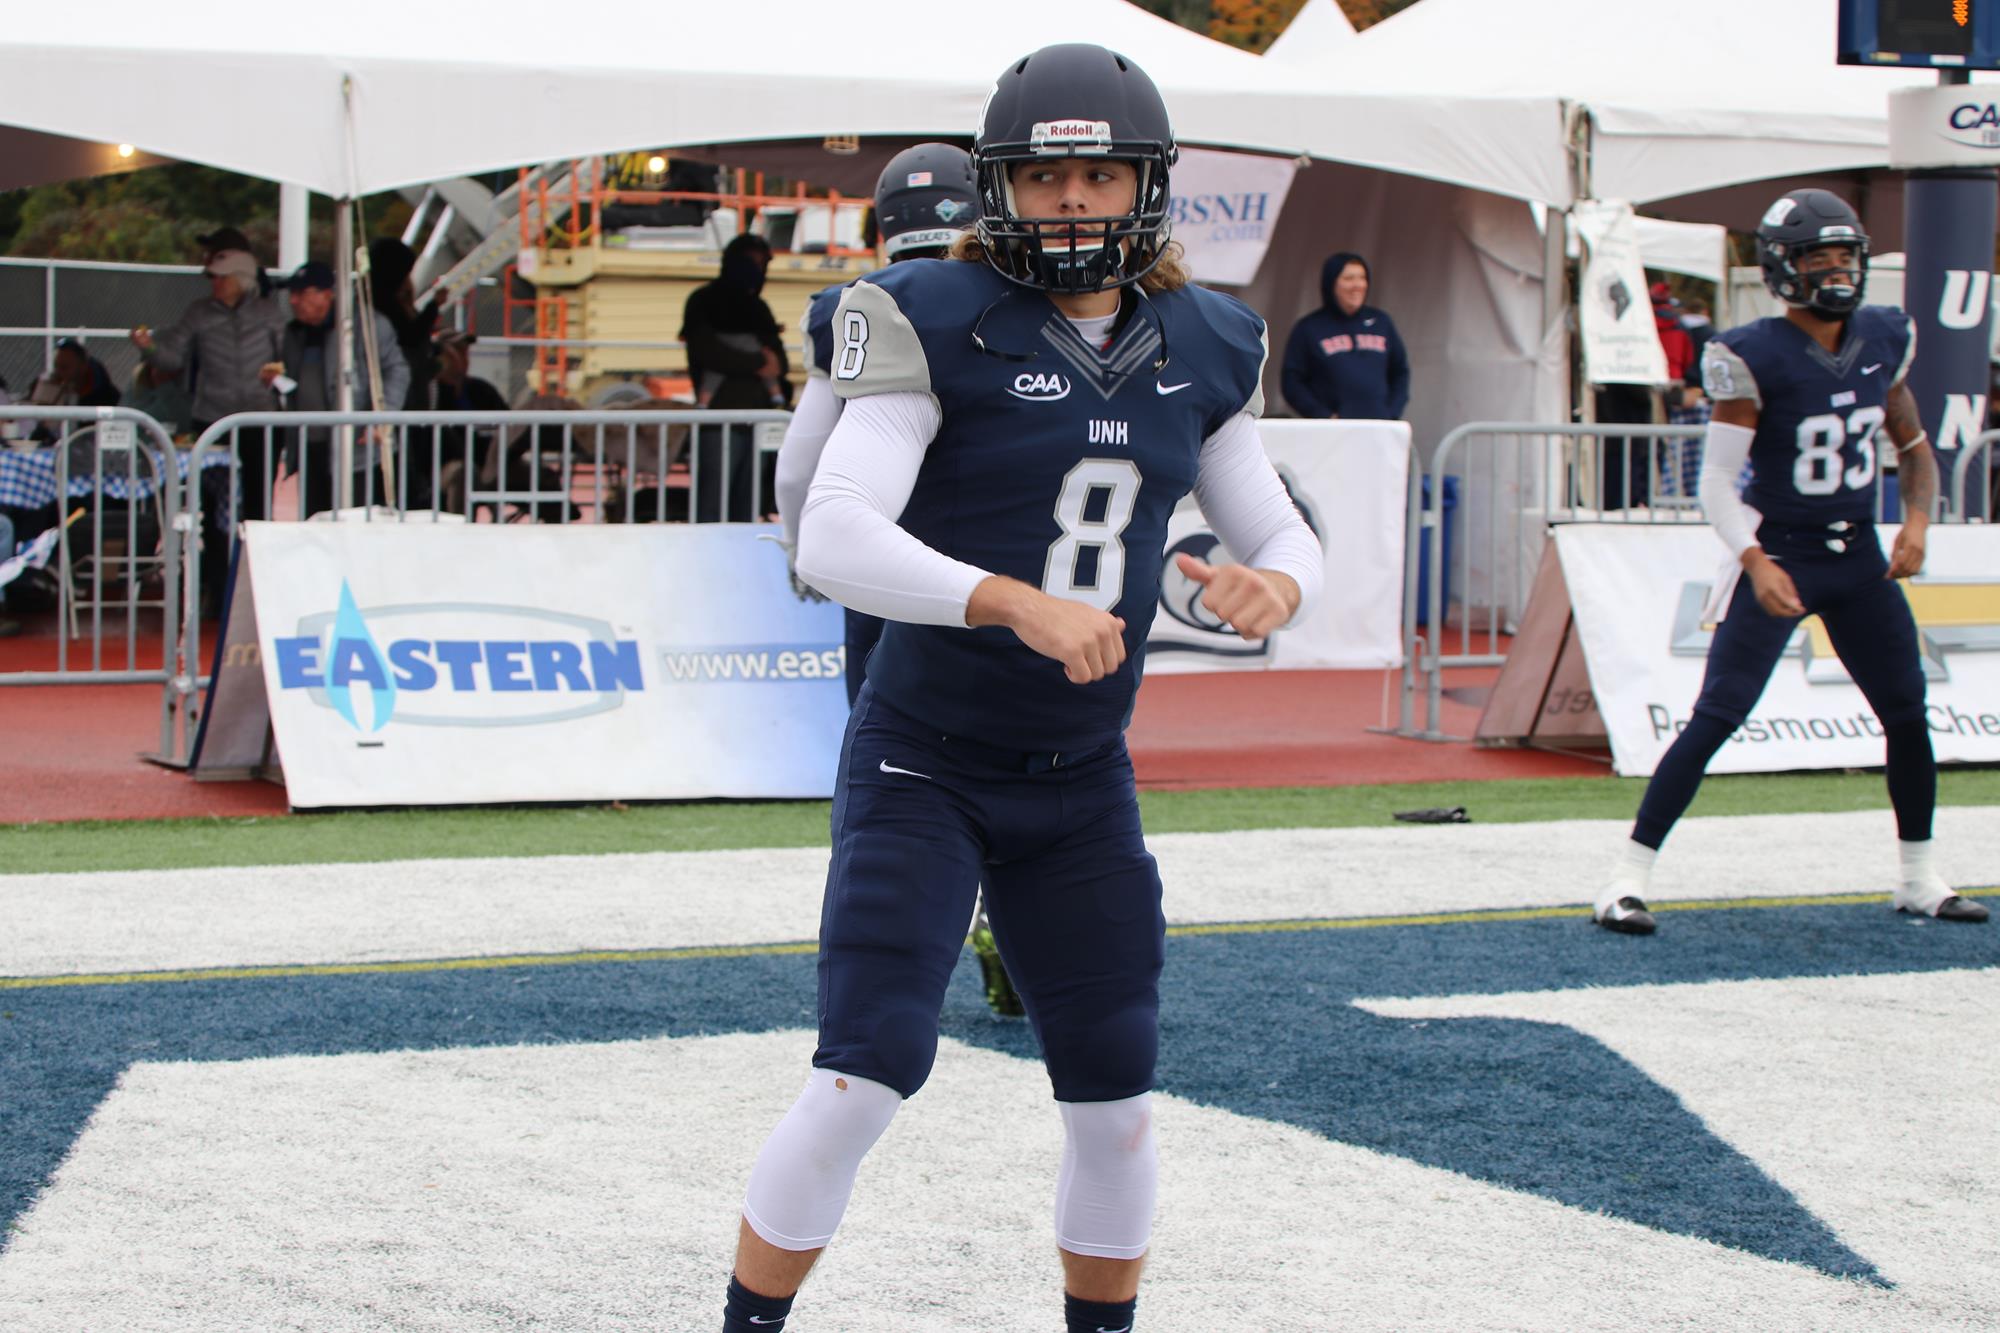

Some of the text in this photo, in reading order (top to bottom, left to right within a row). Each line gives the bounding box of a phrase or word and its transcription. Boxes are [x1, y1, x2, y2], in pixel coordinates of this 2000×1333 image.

[1050, 124, 1093, 136] Riddell
[1949, 103, 2000, 129] CA
[1168, 192, 1269, 224] BSNH
[901, 230, 951, 245] WILDCATS
[837, 309, 870, 381] 8
[1014, 373, 1063, 393] CAA
[1088, 419, 1128, 445] UNH
[1793, 405, 1886, 495] 83
[1041, 457, 1143, 612] 8
[273, 636, 645, 692] EASTERN
[664, 644, 847, 680] www.east
[1647, 704, 1886, 743] Psmout
